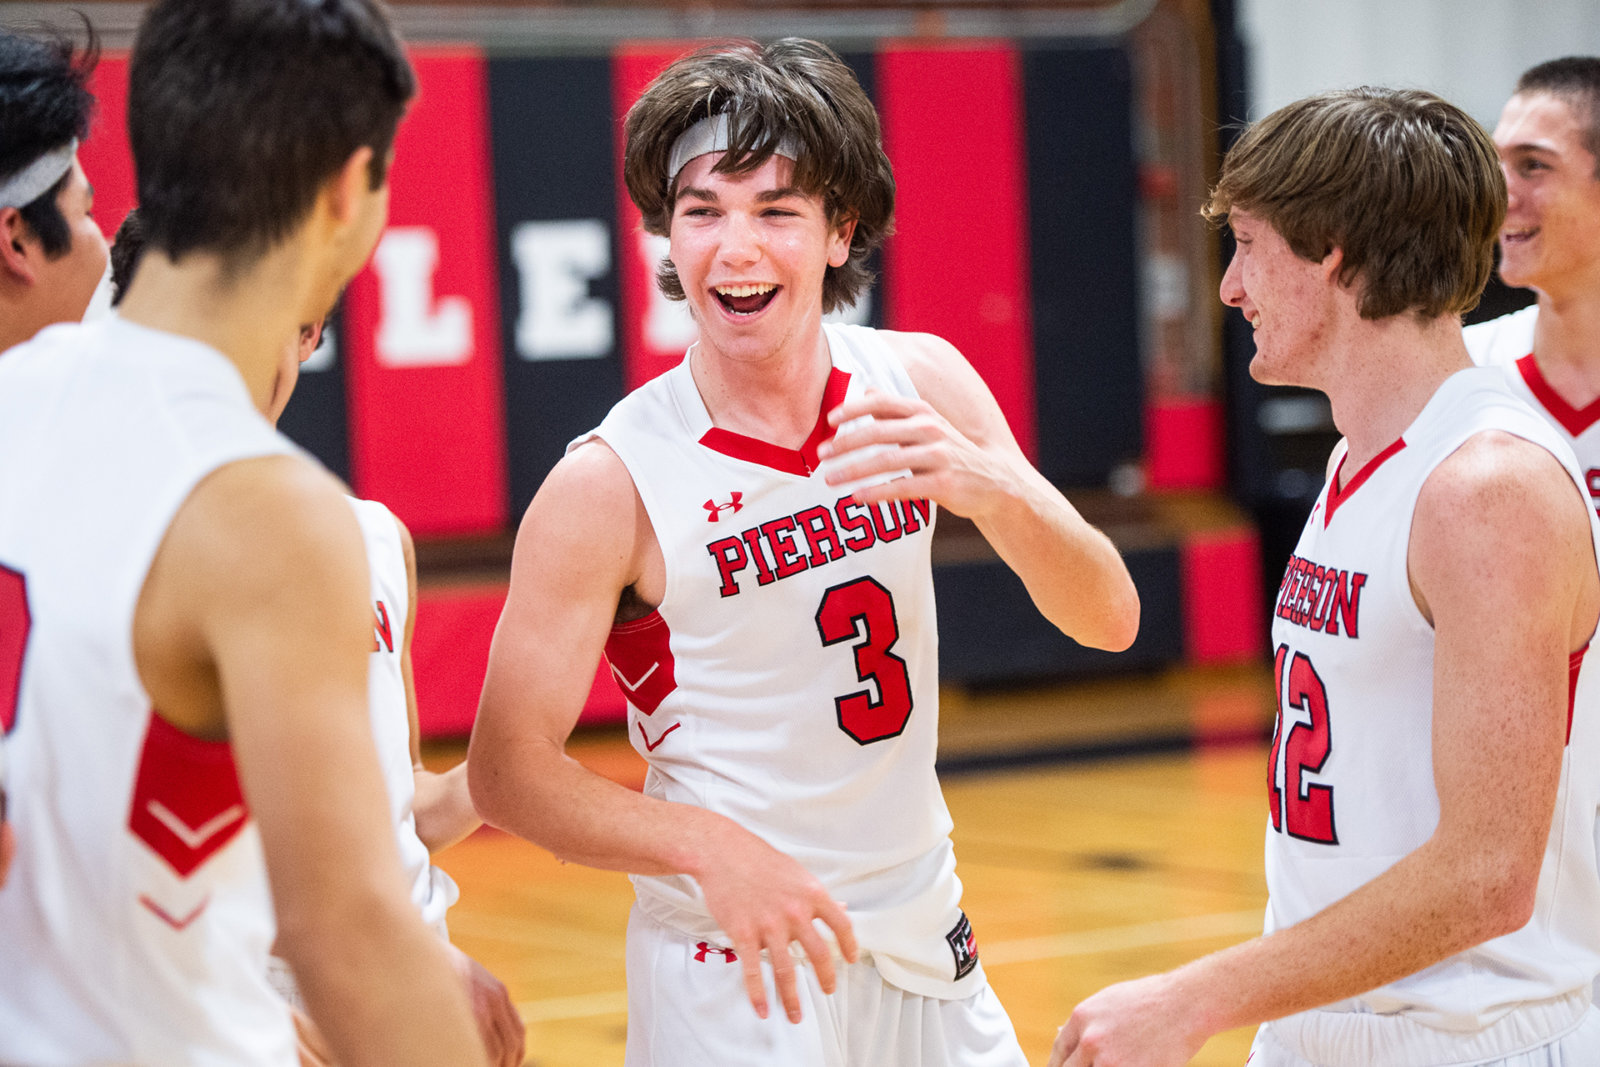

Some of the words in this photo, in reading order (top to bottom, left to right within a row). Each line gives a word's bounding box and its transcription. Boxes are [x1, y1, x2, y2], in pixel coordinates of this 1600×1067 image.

[706, 493, 931, 598] PIERSON
[815, 575, 914, 746] 3
[1267, 642, 1340, 846] 12
